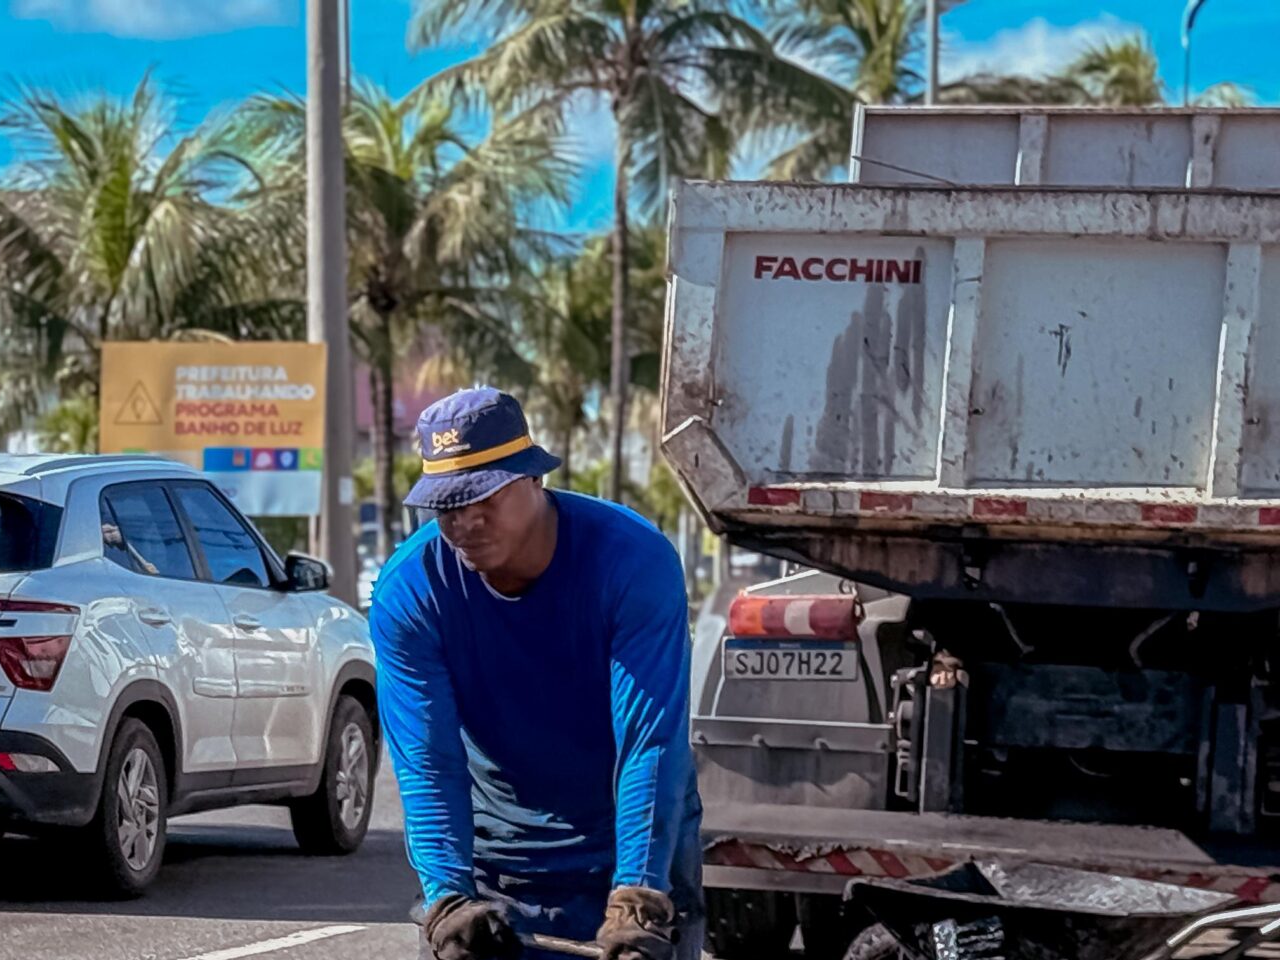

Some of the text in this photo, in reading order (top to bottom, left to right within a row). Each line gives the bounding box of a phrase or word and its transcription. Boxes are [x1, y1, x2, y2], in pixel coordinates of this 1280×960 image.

[754, 255, 922, 284] FACCHINI
[175, 365, 288, 382] PREFEITURA
[175, 403, 279, 416] PROGRAMA
[175, 421, 304, 436] BANHO DE LUZ
